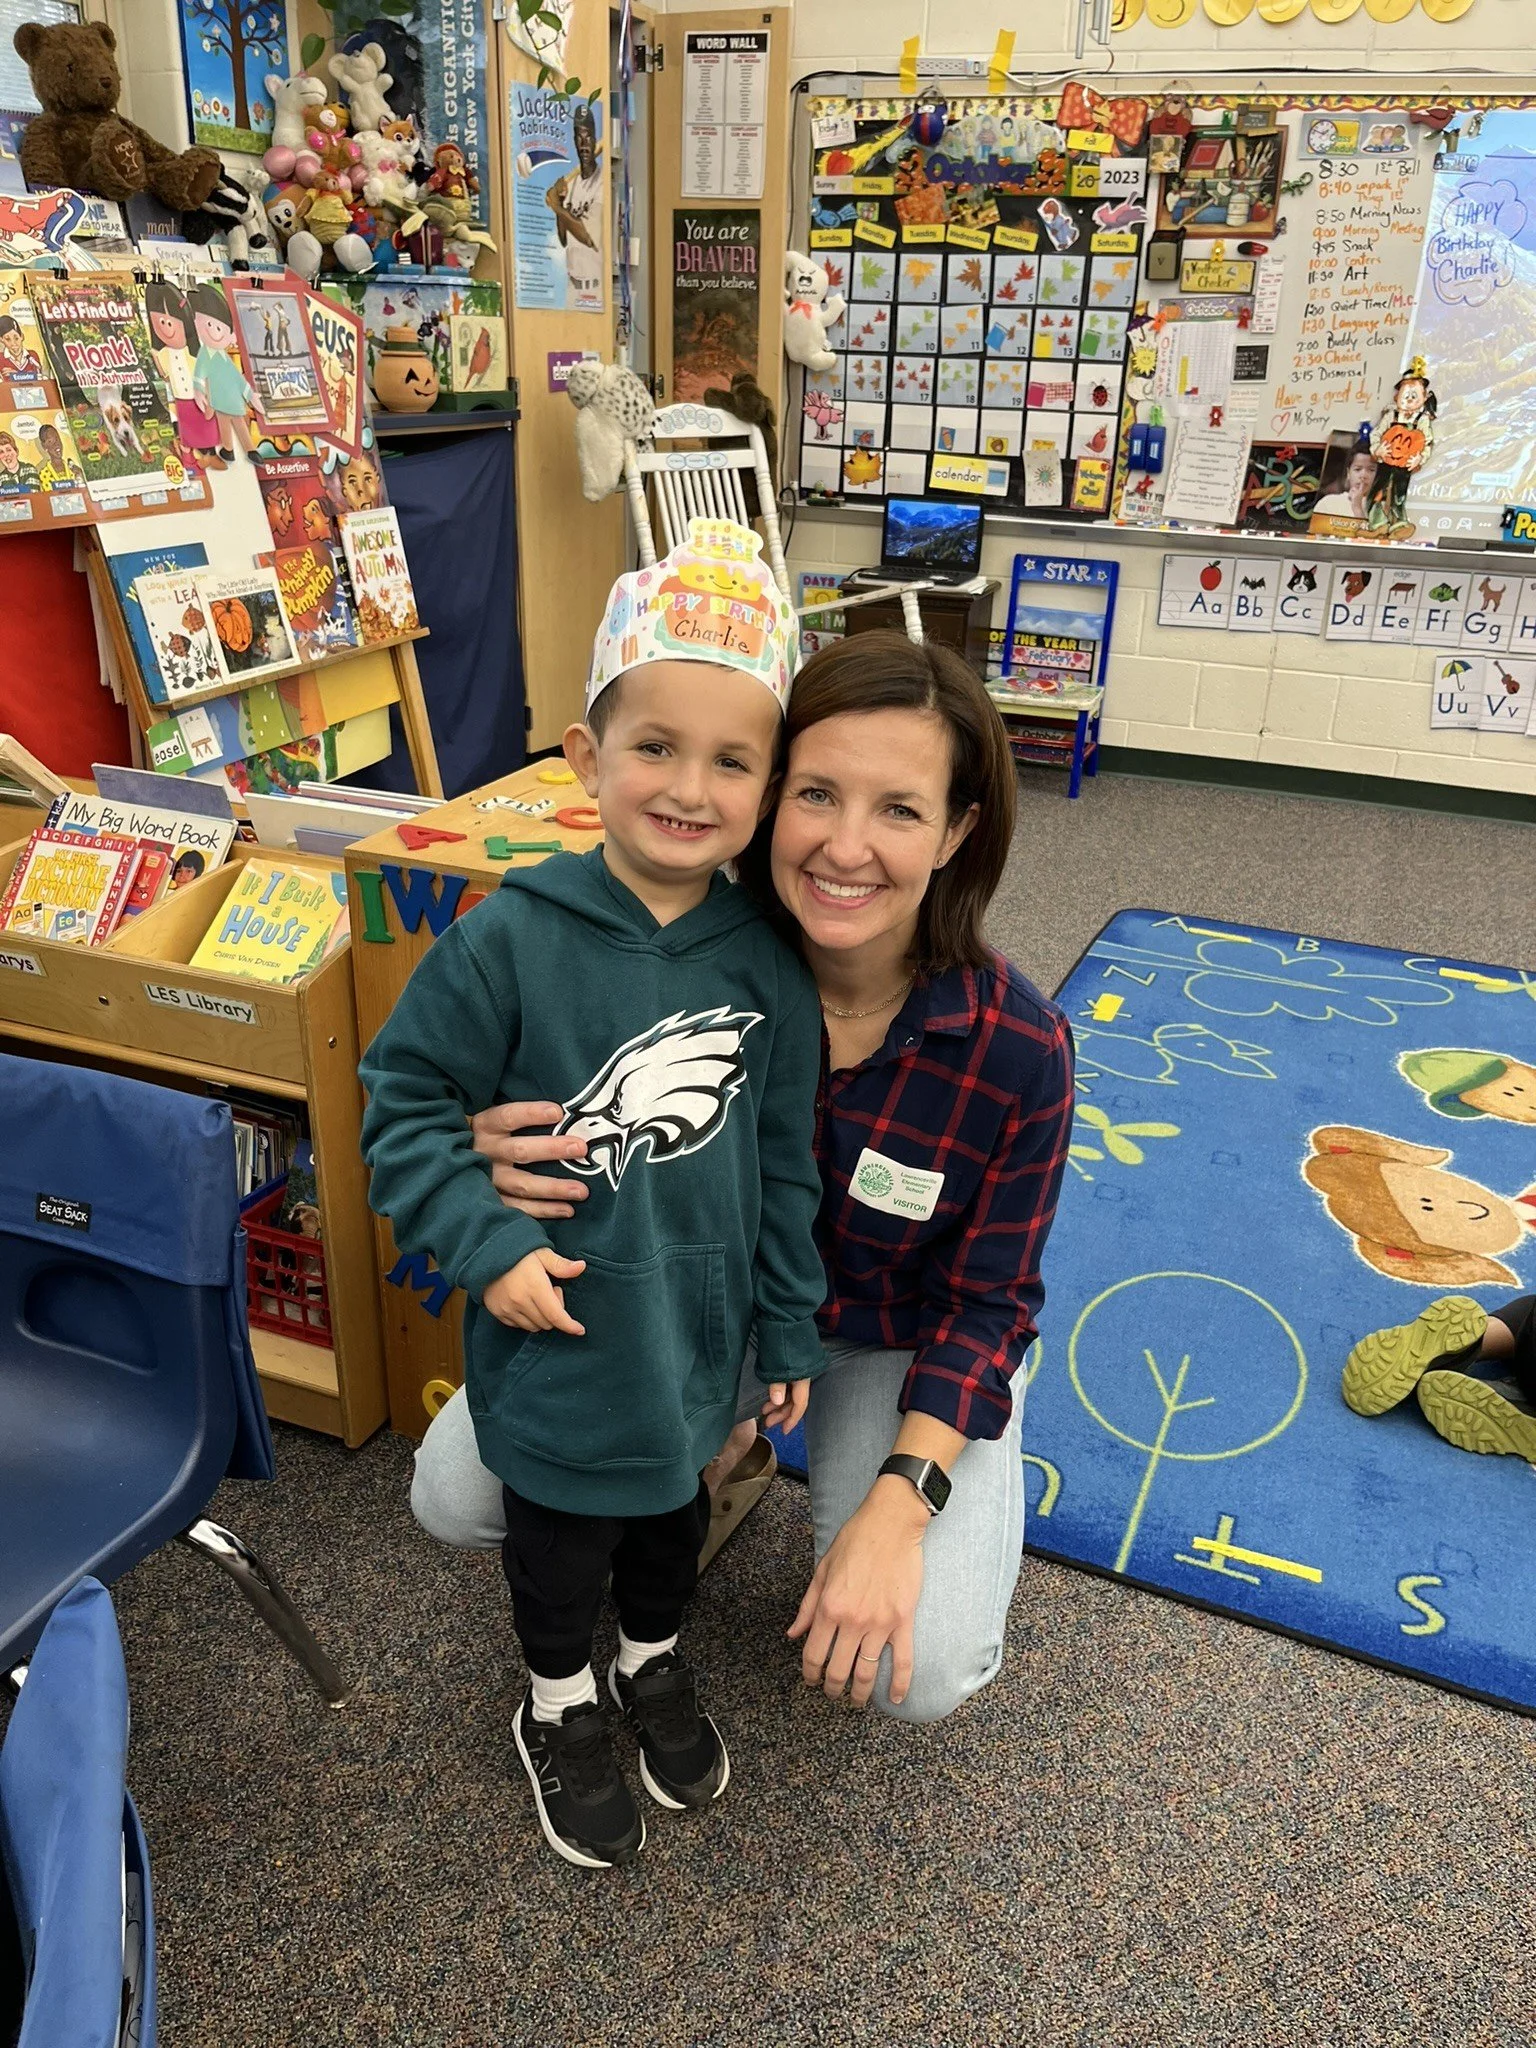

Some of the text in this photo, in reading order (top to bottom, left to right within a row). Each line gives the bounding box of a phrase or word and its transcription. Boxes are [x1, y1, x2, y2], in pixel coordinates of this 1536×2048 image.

[696, 37, 759, 50] WORD WALL
[462, 43, 476, 94] York
[517, 91, 567, 125] Jackie
[464, 98, 478, 146] New
[518, 119, 566, 142] Robinson
[446, 124, 459, 142] is
[114, 140, 134, 153] HOPE
[467, 152, 478, 170] is
[1319, 159, 1359, 179] 8:30
[1396, 160, 1420, 176] Bell
[816, 181, 836, 190] Sunny
[1103, 170, 1140, 184] 2023
[862, 182, 883, 191] Friday
[1319, 181, 1352, 198] 8:40
[1316, 202, 1421, 228] 8:50 Morning News
[1455, 199, 1505, 227] HAPPY
[685, 219, 749, 241] You are
[818, 234, 843, 243] Sunday
[862, 226, 887, 242] Monday
[909, 230, 937, 239] Tuesday
[950, 230, 986, 246] Wednesday
[1313, 221, 1425, 243] 9:00 Morning Meeting
[1000, 232, 1030, 246] Thursday
[1097, 239, 1130, 249] Saturday
[1312, 238, 1374, 257] 9:45 Snack
[1436, 232, 1494, 262] Birthday
[676, 242, 757, 273] BRAVER
[1309, 252, 1381, 269] 10:00 Centers
[1308, 266, 1368, 284] 11:30 Art
[1438, 254, 1499, 283] Charlie
[676, 276, 757, 291] than you believe.
[885, 291, 891, 299] 2
[932, 291, 937, 300] 3
[1028, 294, 1034, 302] 5
[1072, 295, 1078, 304] 6
[1124, 296, 1131, 305] 7
[42, 300, 134, 319] Let's Find Out
[1186, 303, 1228, 316] October
[1331, 299, 1359, 312] Quiet
[1302, 312, 1409, 334] 1:30 Language Arts
[311, 310, 356, 377] euss
[839, 339, 846, 348] 8
[880, 341, 887, 350] 9
[925, 342, 935, 351] 10
[971, 341, 980, 350] 11
[1016, 346, 1027, 355] 12
[1297, 331, 1395, 353] 2:00 Buddy class
[64, 334, 139, 371] Plonk!
[1063, 348, 1073, 356] 13
[1111, 350, 1121, 359] 14
[1293, 350, 1362, 368] 2:30 Choice
[76, 370, 146, 387] It Is Autumn!
[1291, 370, 1313, 383] 3:15
[833, 389, 842, 398] 15
[874, 391, 884, 400] 16
[920, 393, 929, 402] 17
[965, 395, 975, 404] 18
[1012, 397, 1022, 406] 19
[1275, 384, 1302, 409] Have
[165, 463, 183, 478] BIG
[265, 462, 310, 474] Be Assertive
[934, 467, 982, 483] calendar
[351, 529, 398, 555] AWESOME
[283, 558, 298, 574] The
[355, 553, 406, 584] AUTUMN
[1043, 562, 1092, 582] STAR
[803, 576, 835, 587] DAYS
[174, 588, 199, 604] LEA
[284, 564, 334, 621] Pumpkin
[1189, 592, 1222, 615] Aa
[1236, 595, 1263, 618] Bb
[1280, 596, 1311, 619] Cc
[636, 591, 788, 650] HAPPY BIRTHDAY
[1331, 604, 1365, 626] Dd
[1381, 605, 1409, 629] Ee
[1426, 609, 1451, 632] Ff
[1464, 612, 1501, 644] Gg
[674, 619, 751, 655] Charlie
[1043, 637, 1077, 650] YEAR
[1028, 650, 1072, 665] February
[1438, 693, 1468, 714] Uu
[1486, 694, 1519, 718] Vv
[155, 734, 185, 763] easel
[66, 802, 220, 850] My Big Word Book
[71, 851, 100, 866] FIRST
[30, 856, 111, 889] PICTURE
[21, 878, 104, 911] DICTIONARY
[240, 870, 327, 911] If I Built
[14, 909, 31, 920] Aa
[272, 905, 282, 917] a
[218, 904, 310, 953] HOUSE
[1295, 937, 1321, 954] B
[213, 951, 281, 969] CHRIS VAN DUSEN
[146, 984, 253, 1023] LES Library
[900, 1172, 937, 1185] Lawrenceville
[901, 1179, 932, 1190] Elementary
[905, 1187, 924, 1195] School
[40, 1201, 89, 1222] SEAT SACK
[893, 1198, 927, 1213] VISITOR
[1397, 1575, 1447, 1637] S
